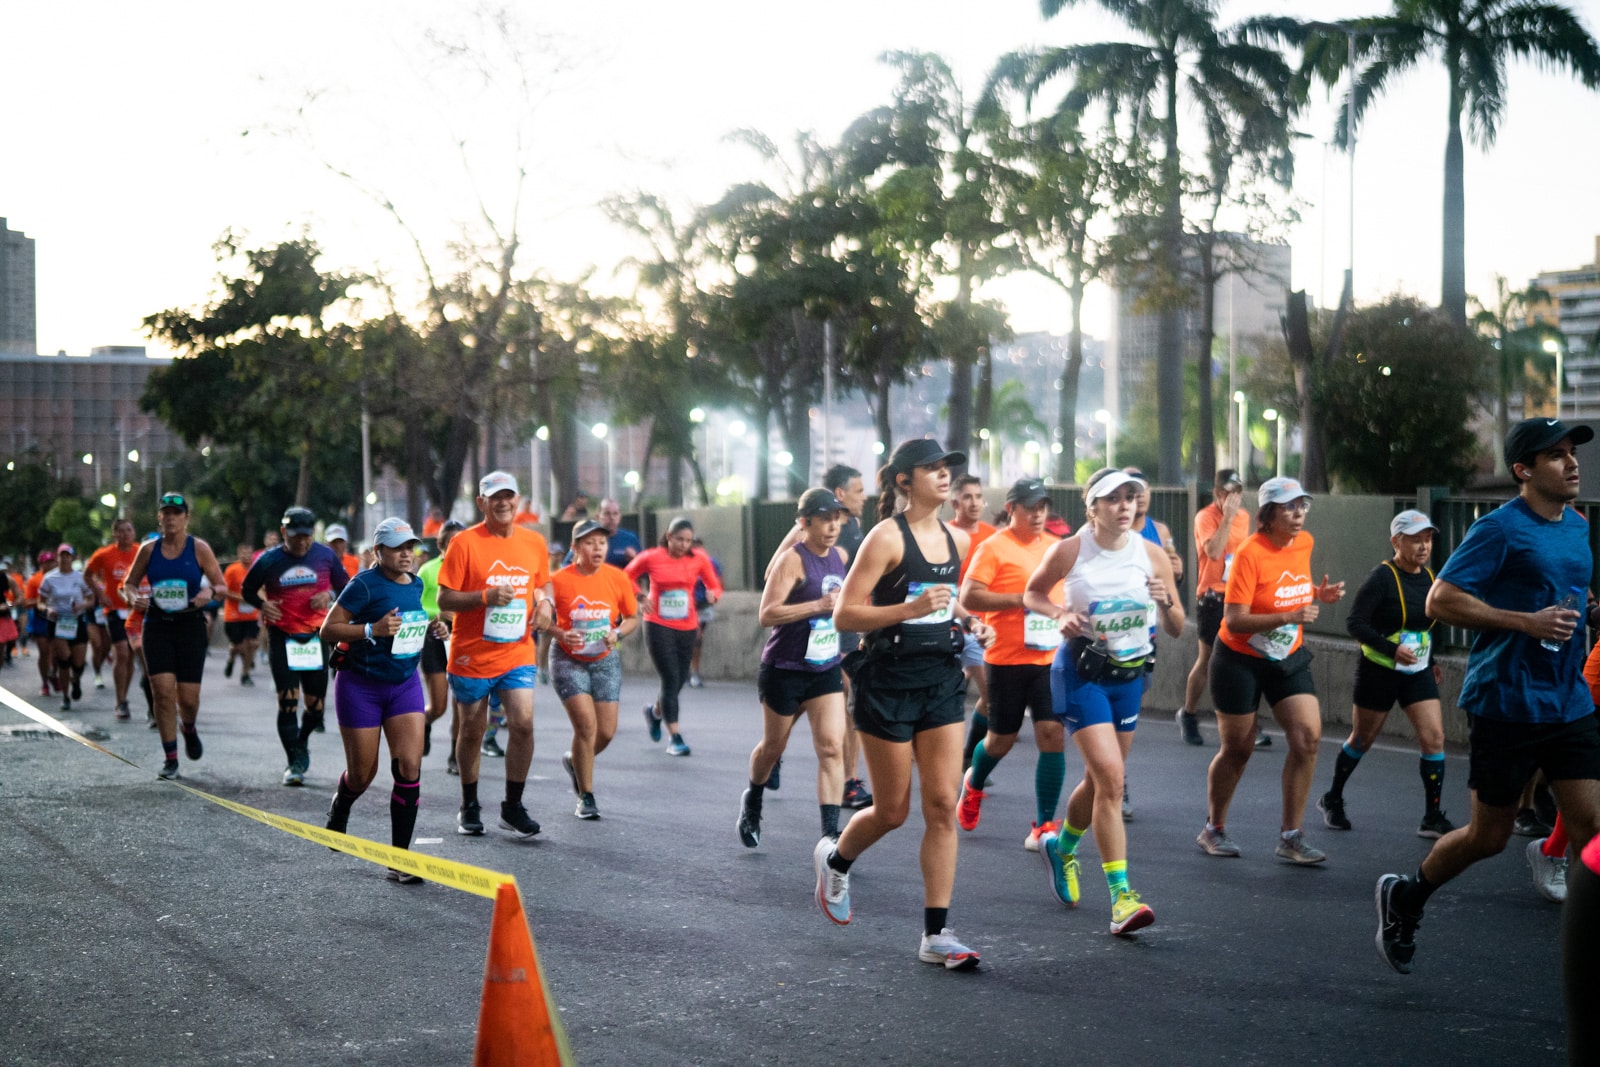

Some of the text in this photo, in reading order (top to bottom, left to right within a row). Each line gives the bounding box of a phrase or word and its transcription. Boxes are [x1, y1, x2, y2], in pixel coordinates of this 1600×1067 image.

[490, 612, 523, 624] 3537
[1095, 615, 1145, 633] 4484
[398, 624, 426, 639] 4770
